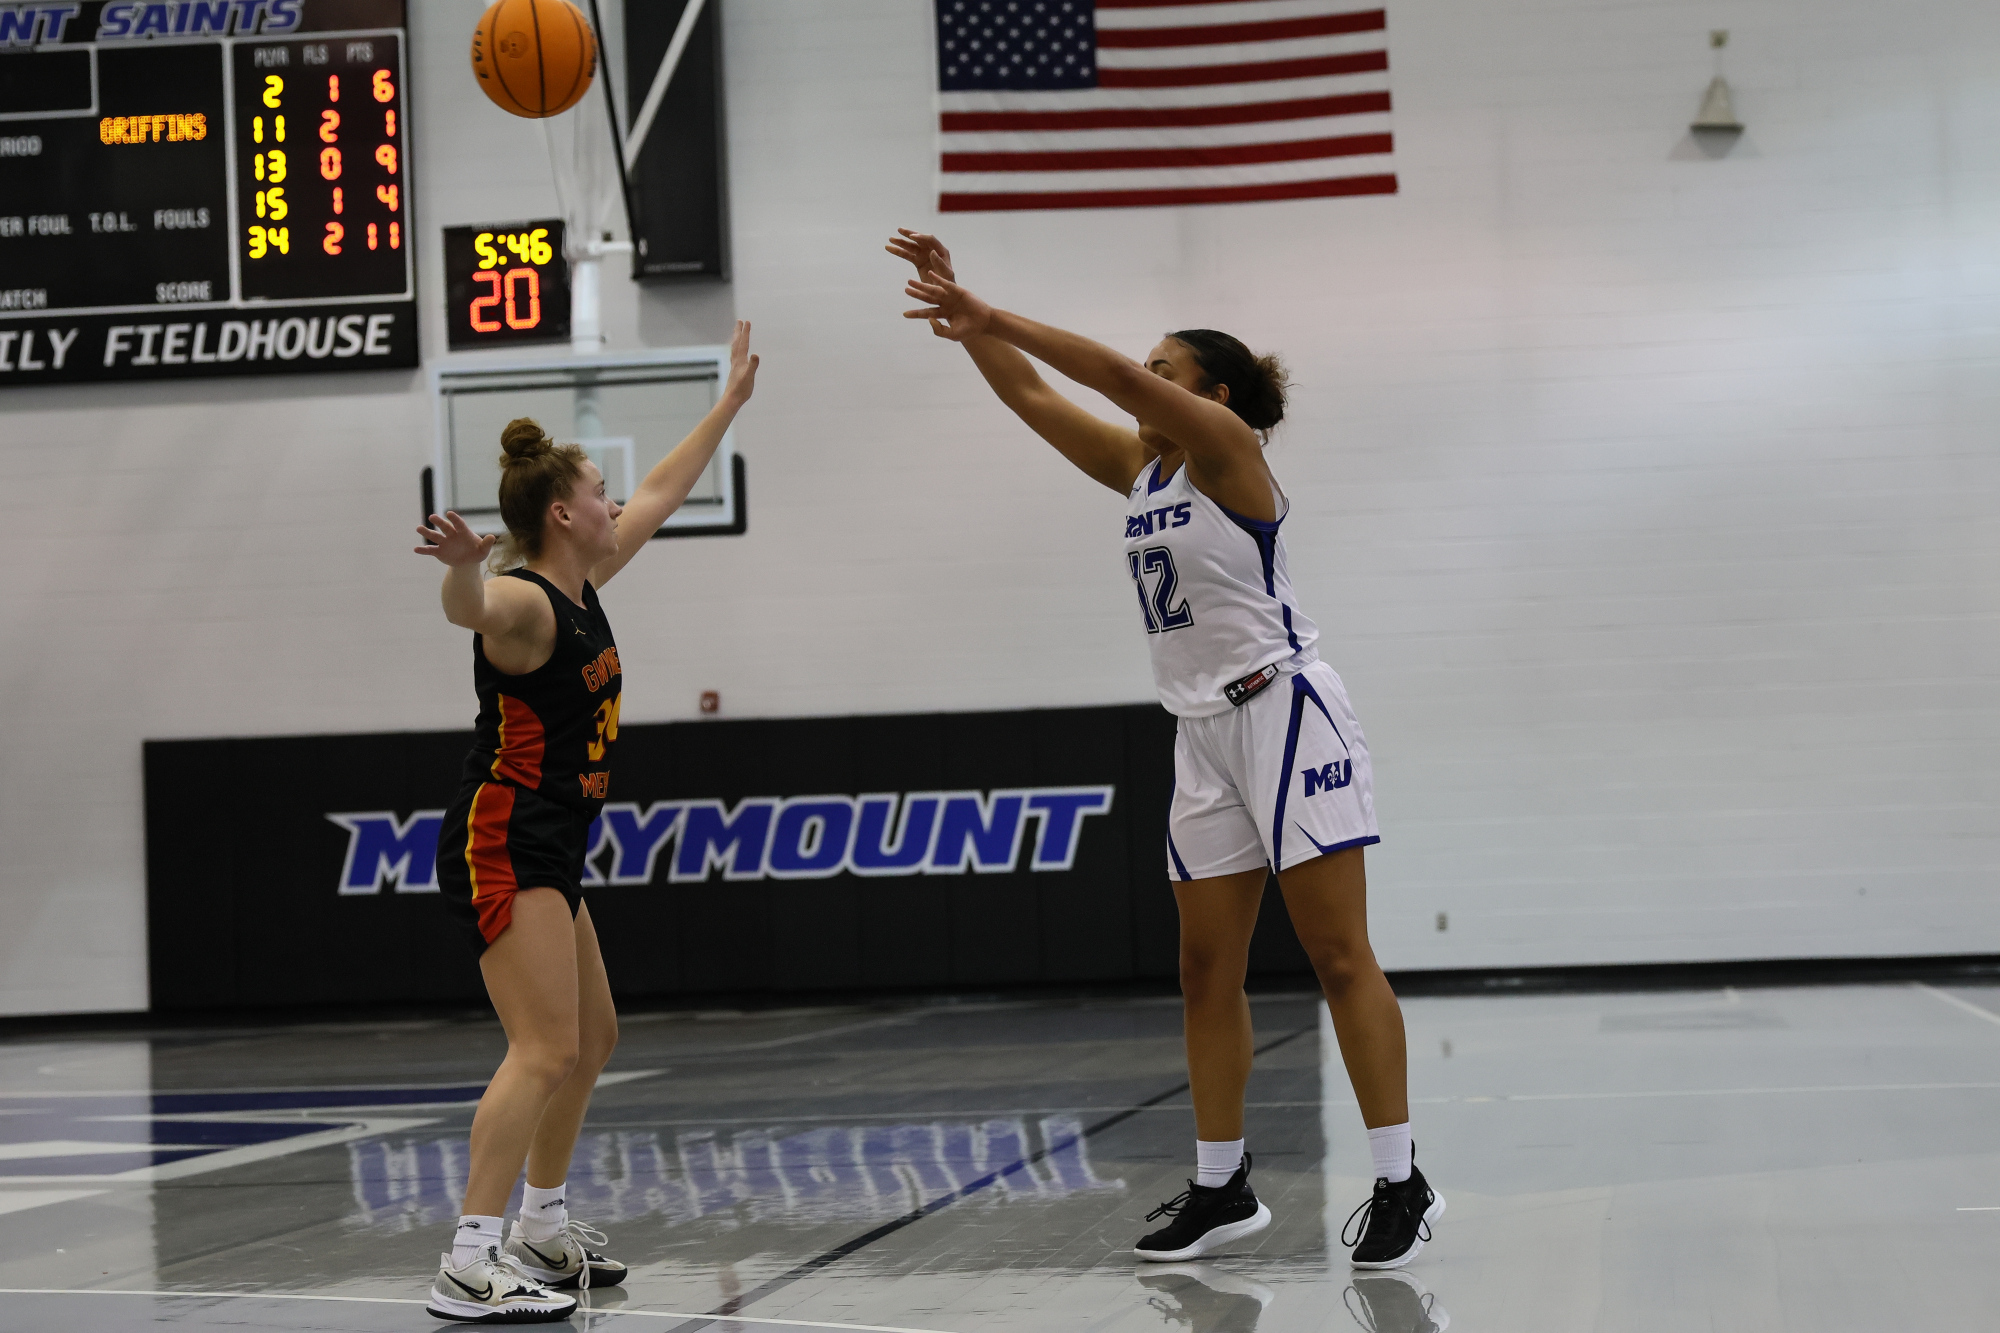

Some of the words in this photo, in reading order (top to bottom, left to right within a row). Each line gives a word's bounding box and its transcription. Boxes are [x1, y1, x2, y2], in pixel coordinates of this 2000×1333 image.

[97, 0, 302, 38] SAINTS
[254, 46, 289, 68] PLYR
[303, 44, 329, 65] FLS
[346, 42, 374, 63] PTS
[263, 75, 284, 108] 2
[328, 75, 339, 103] 1
[373, 69, 395, 103] 6
[100, 113, 206, 144] GRIFFINS
[253, 115, 285, 143] 11
[319, 109, 340, 142] 2
[385, 109, 396, 137] 1
[254, 150, 287, 183] 13
[320, 147, 342, 180] 0
[375, 144, 397, 174] 9
[28, 214, 72, 235] FOUL
[154, 207, 210, 230] FOULS
[256, 187, 288, 220] 15
[332, 187, 343, 214] 1
[376, 184, 398, 212] 4
[248, 225, 289, 259] 34
[323, 221, 344, 255] 2
[367, 221, 399, 251] 11
[474, 228, 552, 269] 5:46
[156, 281, 212, 303] SCORE
[470, 268, 541, 333] 20
[103, 314, 395, 367] FIELDHOUSE
[1301, 759, 1352, 798] MU
[325, 785, 1115, 896] MYMOUNT
